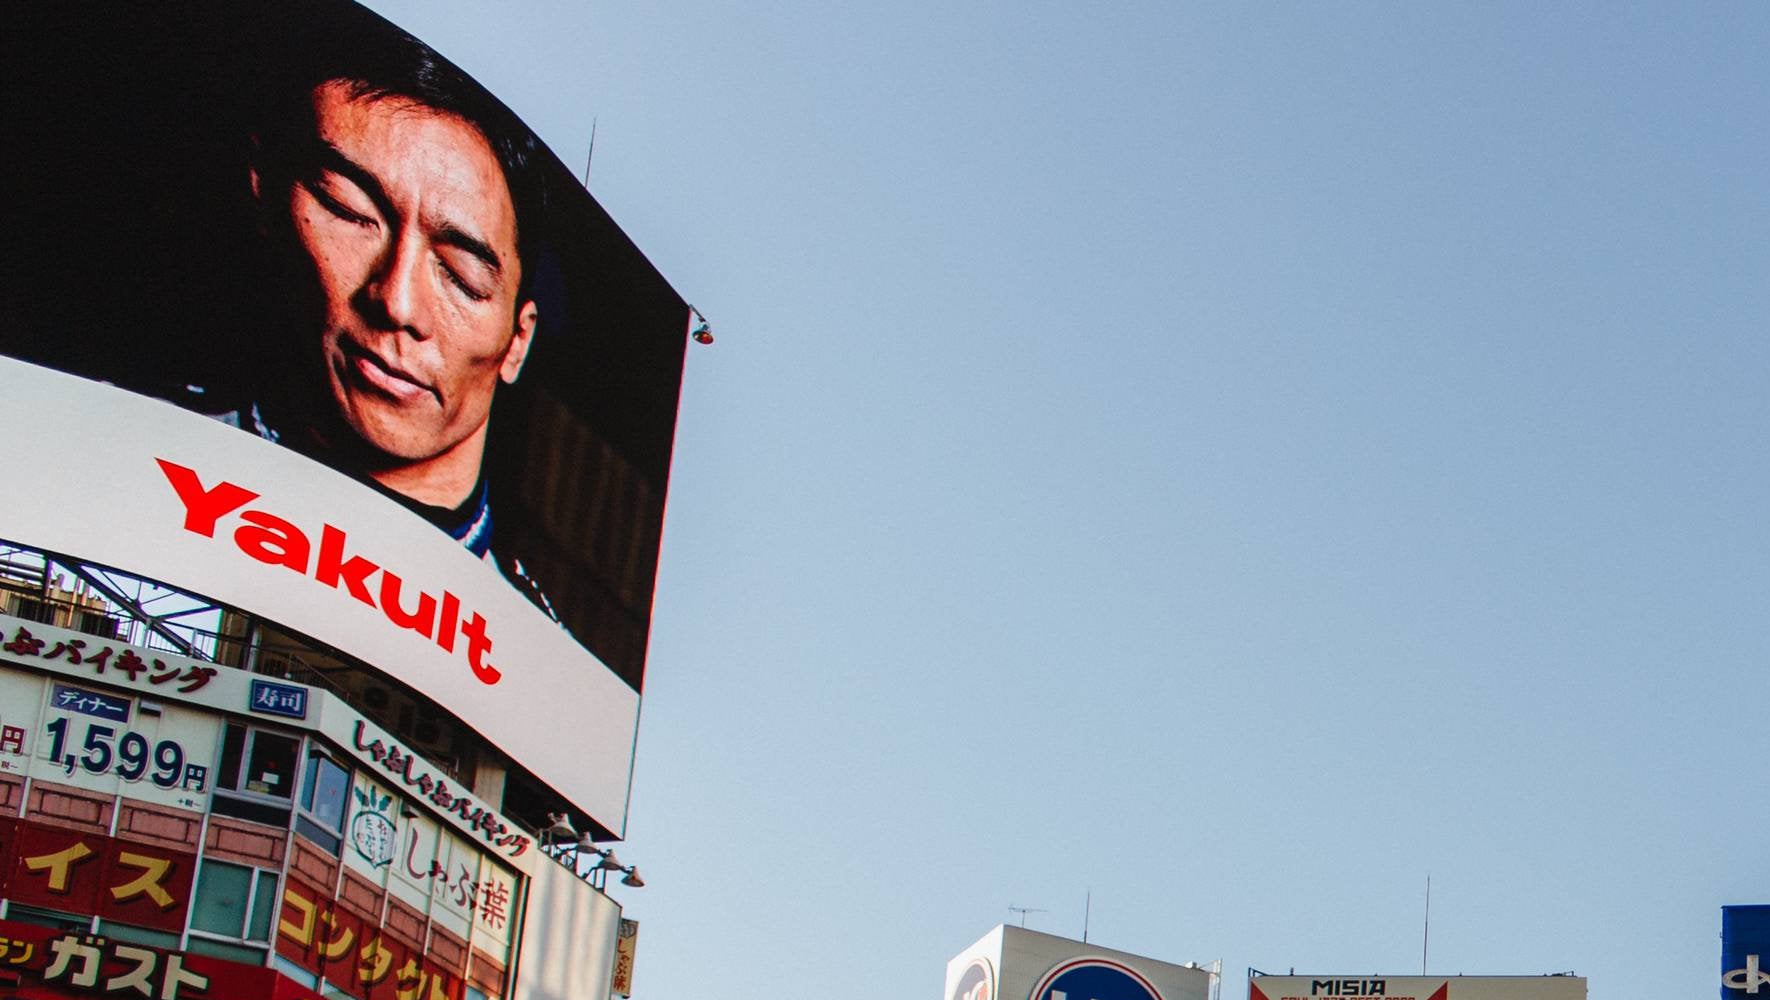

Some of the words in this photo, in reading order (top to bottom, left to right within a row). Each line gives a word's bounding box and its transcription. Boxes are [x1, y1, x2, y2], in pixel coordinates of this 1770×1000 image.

[154, 457, 502, 685] Yakult
[0, 627, 219, 693] ぶバイキング
[58, 690, 124, 713] ディナー
[256, 686, 301, 713] 寿司
[46, 716, 208, 794] 1,599円
[353, 718, 533, 858] しゃぶしゃぶバイキング
[24, 841, 175, 909] イス
[43, 935, 209, 1000] ガスト
[1311, 979, 1387, 996] MISIA
